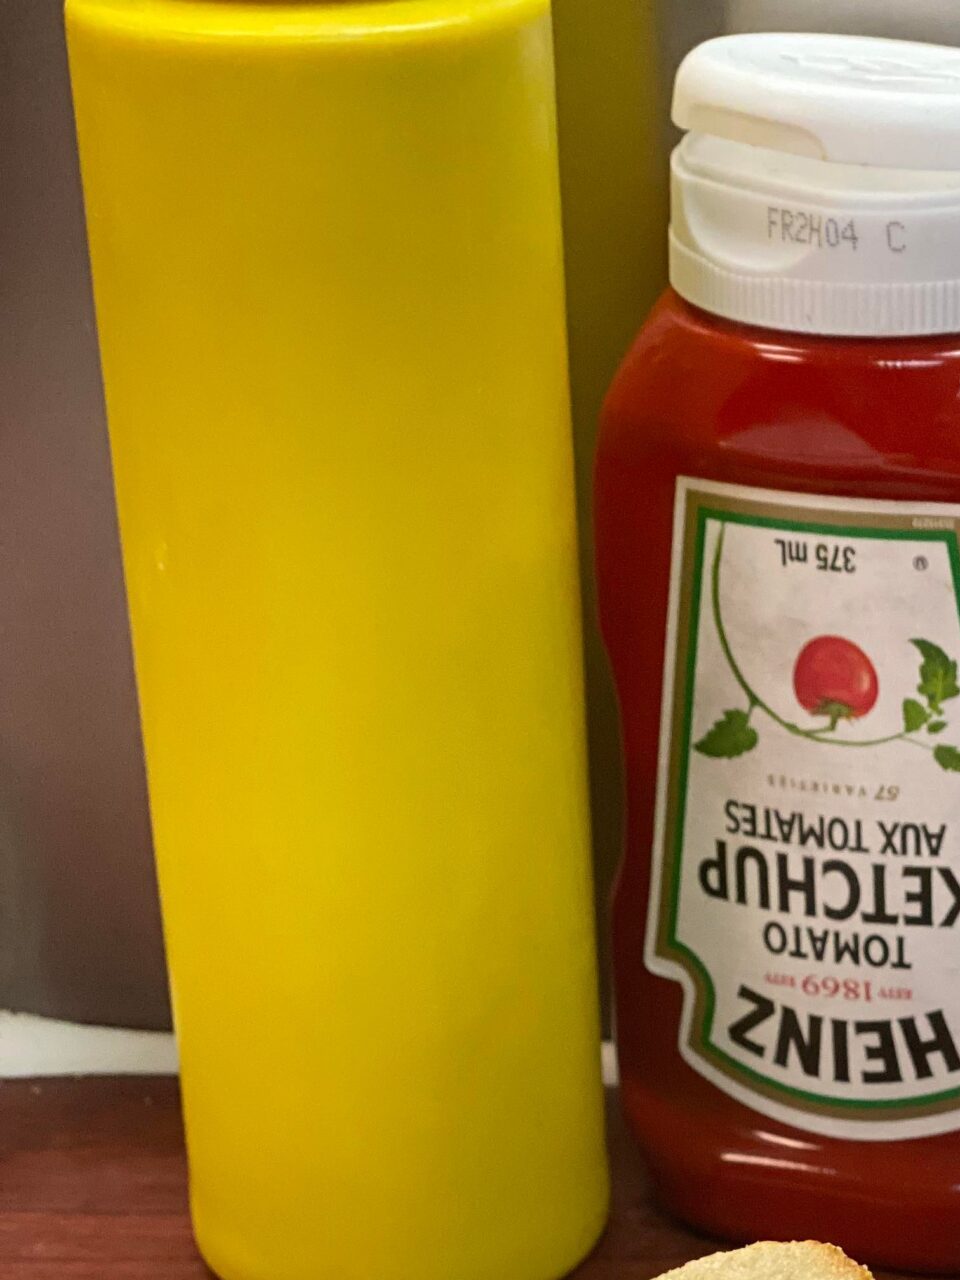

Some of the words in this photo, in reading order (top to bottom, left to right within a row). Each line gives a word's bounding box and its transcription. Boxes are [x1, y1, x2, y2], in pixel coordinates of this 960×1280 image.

[774, 538, 807, 567] mL
[816, 545, 856, 573] 375
[725, 800, 869, 854] TOMATES
[879, 821, 947, 856] AUX
[763, 921, 912, 970] TOMATO
[802, 974, 873, 1003] 1869
